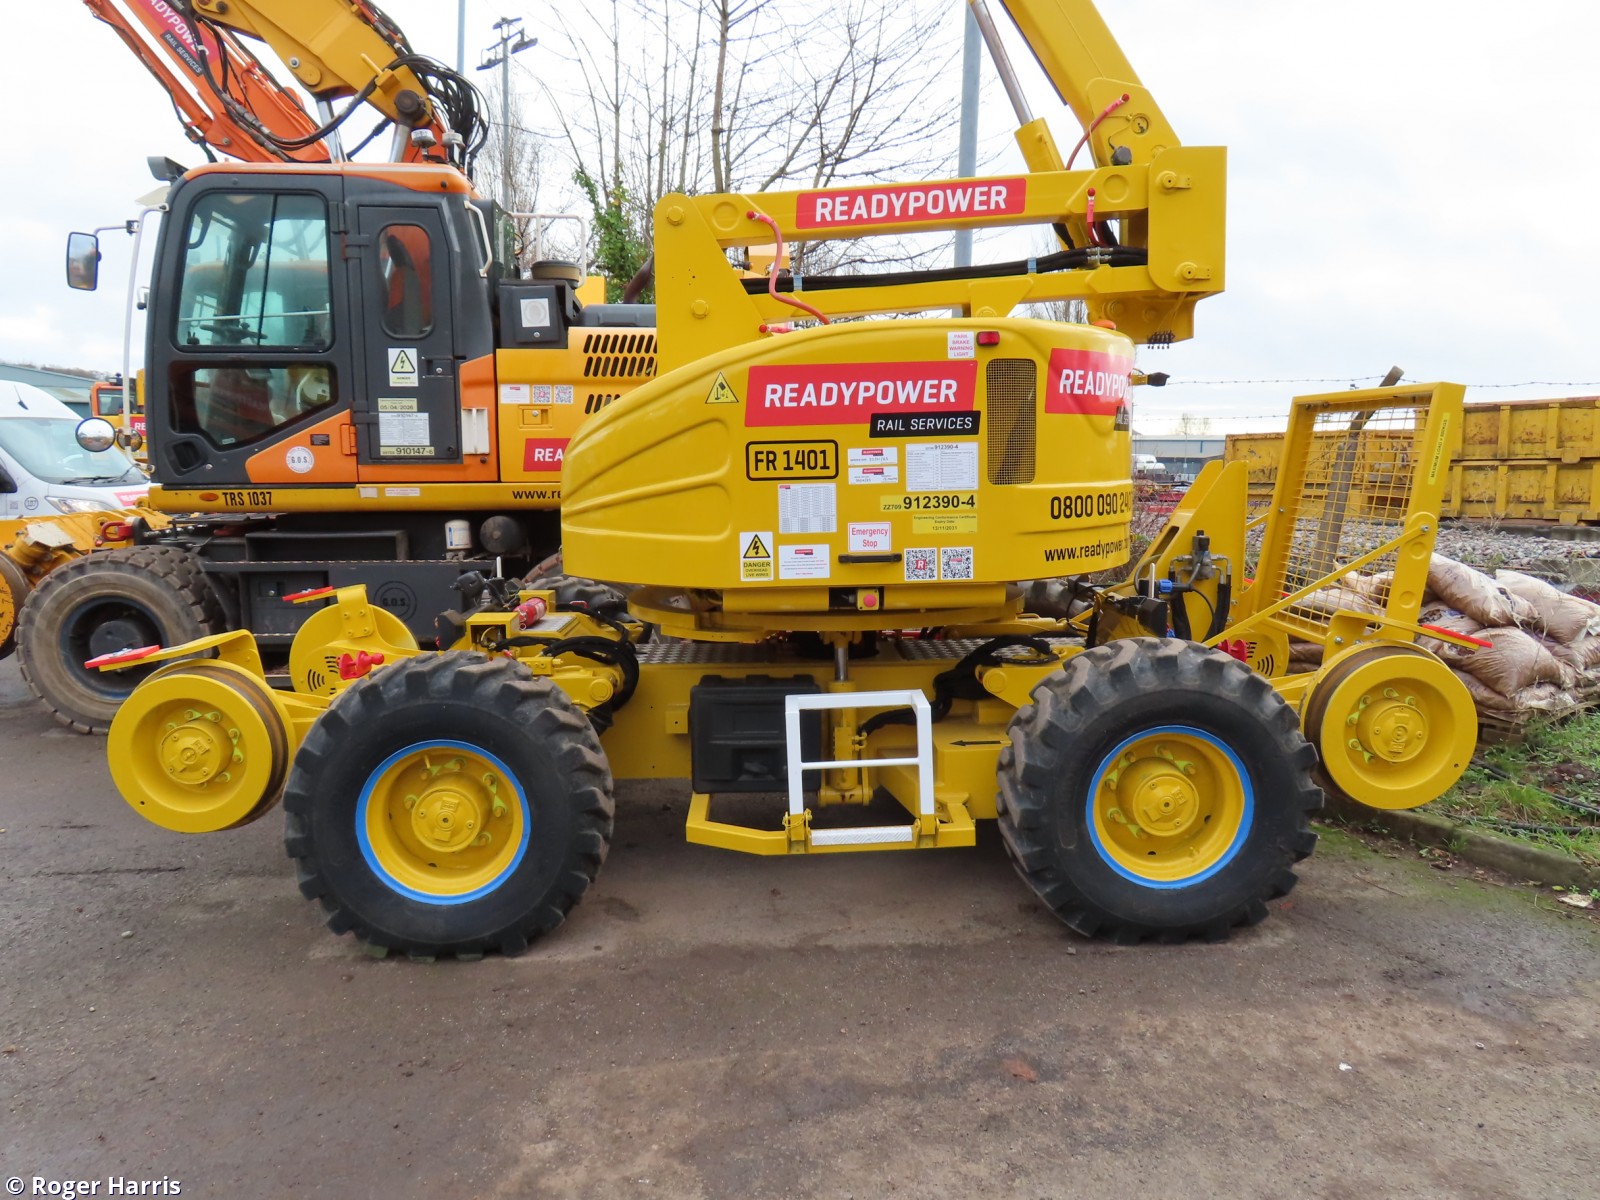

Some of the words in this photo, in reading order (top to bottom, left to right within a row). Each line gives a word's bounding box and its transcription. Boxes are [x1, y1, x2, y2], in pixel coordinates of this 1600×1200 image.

[164, 33, 176, 47] RAIL
[176, 46, 202, 73] SERVICES
[815, 186, 1007, 222] READYPOWER
[764, 379, 958, 408] READYPOWER
[877, 419, 905, 431] RAIL
[910, 417, 972, 430] SERVICES
[754, 450, 777, 471] FR
[783, 449, 830, 470] 1401
[222, 492, 245, 506] TRS
[248, 491, 272, 506] 1037
[903, 495, 975, 509] 912390-4
[1050, 494, 1093, 520] 0800
[1097, 493, 1117, 516] 090
[851, 527, 888, 537] Emergency
[862, 539, 878, 548] Stop
